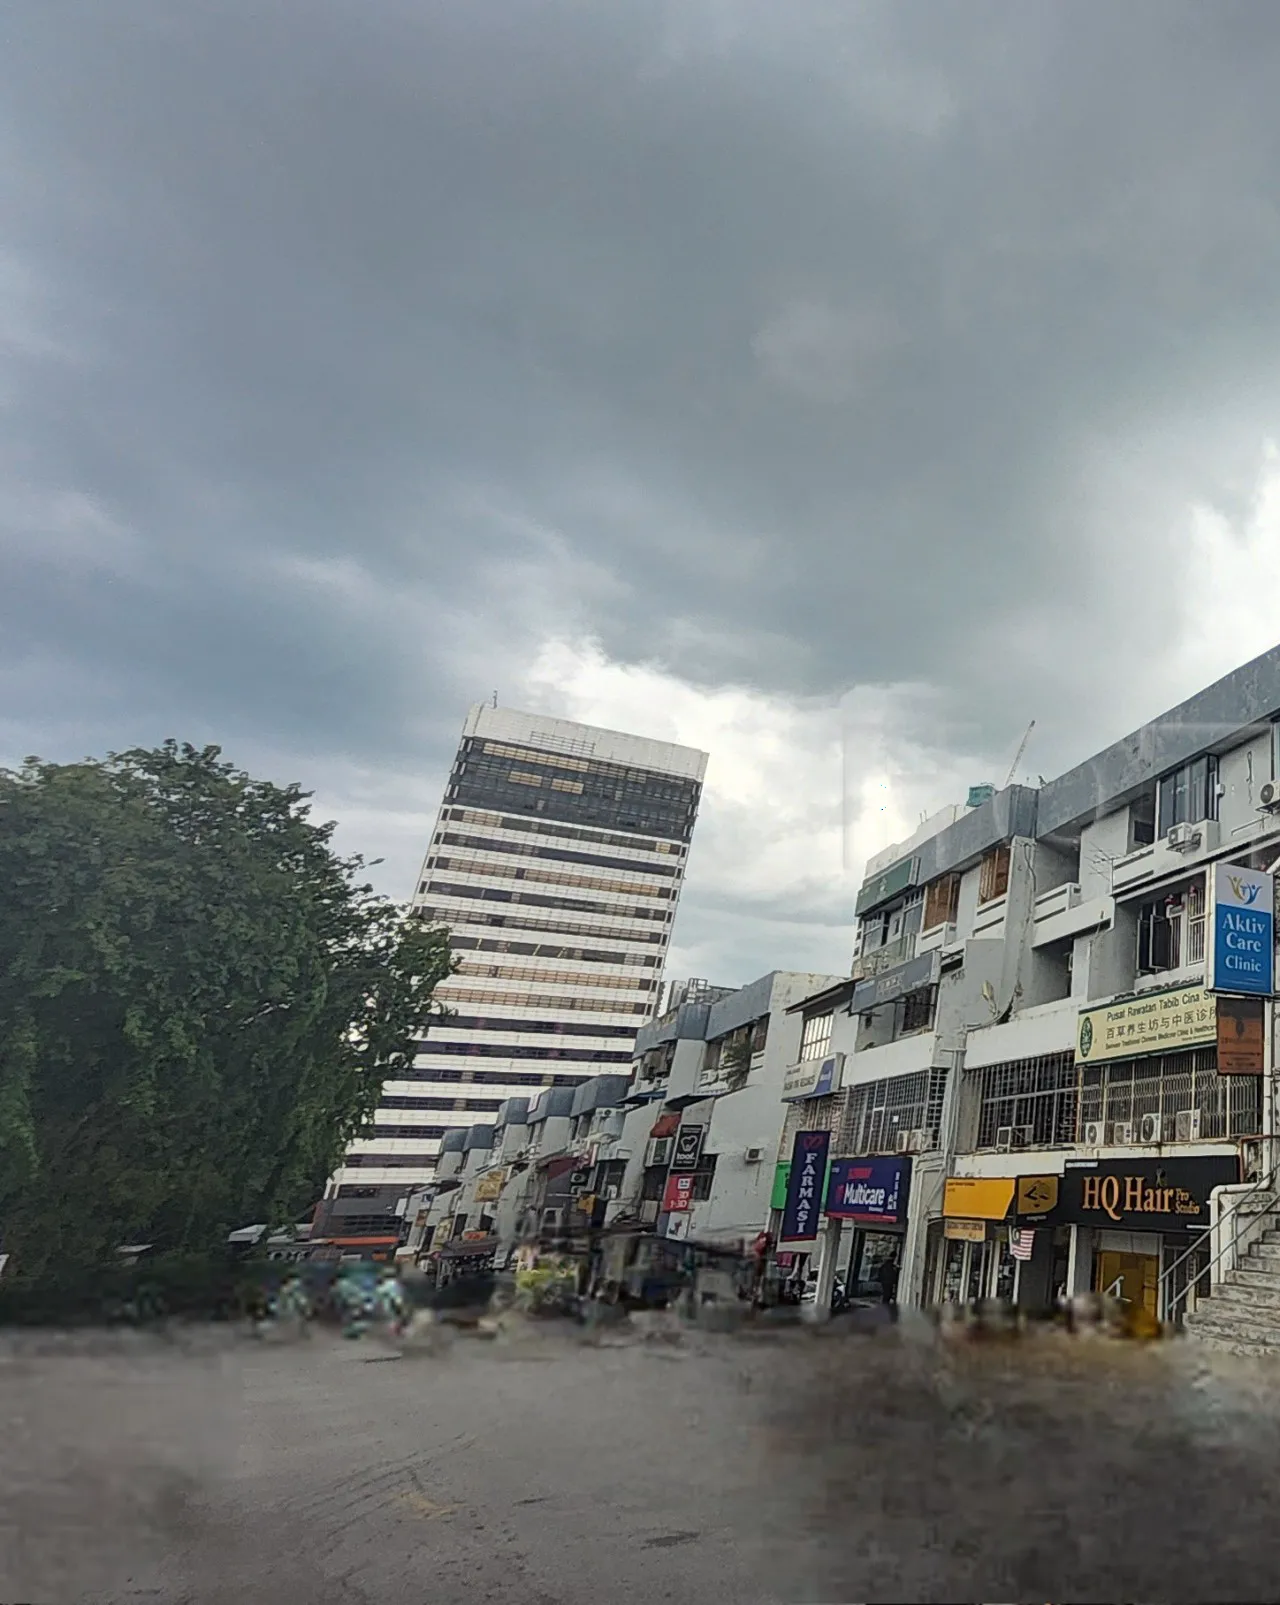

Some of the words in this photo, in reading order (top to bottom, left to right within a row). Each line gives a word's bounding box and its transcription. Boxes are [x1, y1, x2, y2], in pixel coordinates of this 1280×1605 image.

[1222, 912, 1266, 934] Aktiv
[1226, 932, 1262, 953] Care
[1225, 955, 1262, 972] Clinic
[1107, 1010, 1125, 1022] Pusat
[1159, 997, 1180, 1009] Tabib
[1182, 992, 1200, 1005] Cina
[797, 1152, 818, 1234] FARMASI
[843, 1182, 885, 1206] Multicare
[1082, 1175, 1123, 1221] HQ
[1124, 1176, 1174, 1213] Hair
[1175, 1187, 1190, 1201] Pro
